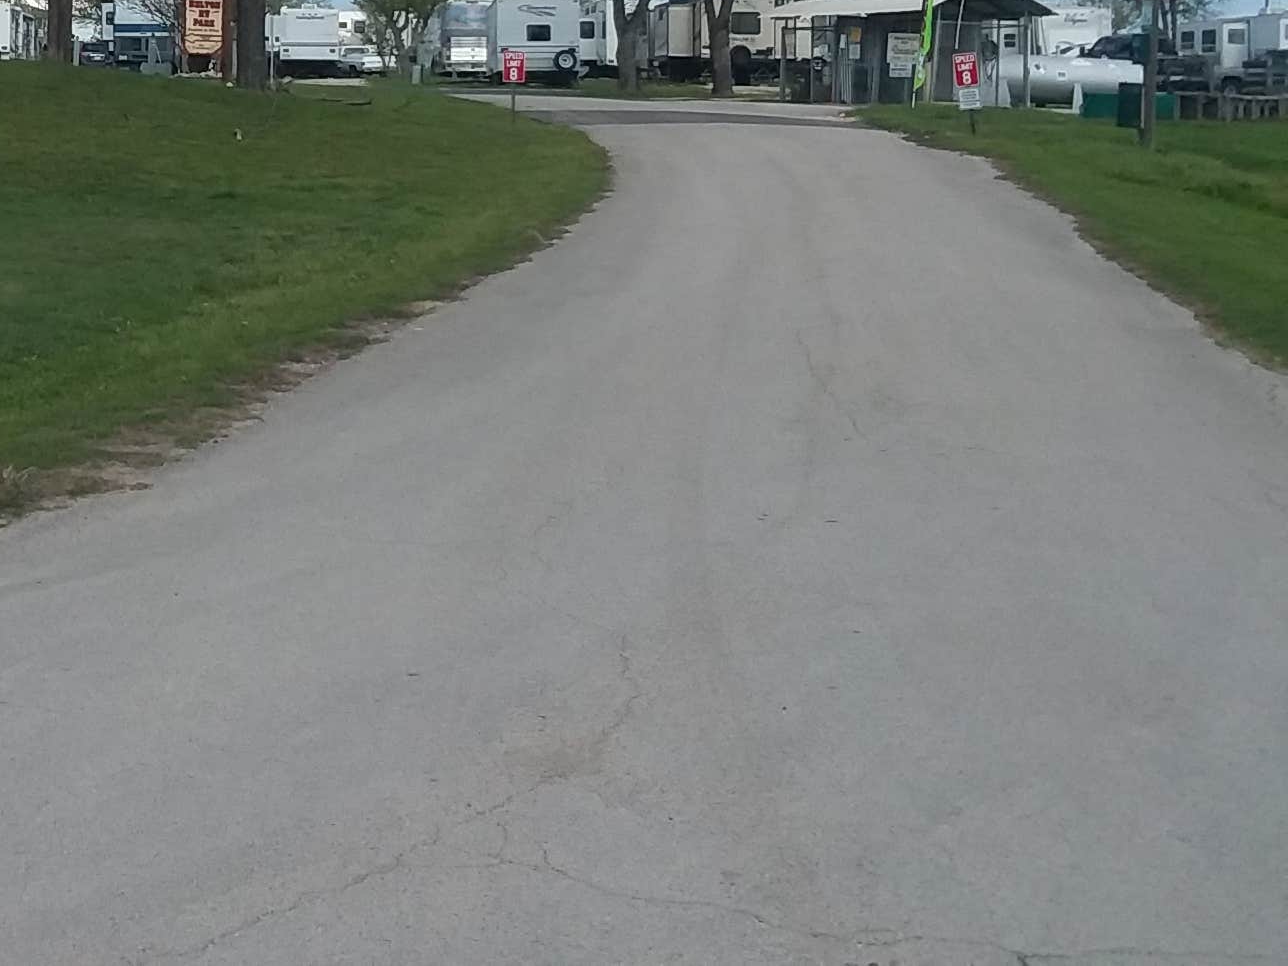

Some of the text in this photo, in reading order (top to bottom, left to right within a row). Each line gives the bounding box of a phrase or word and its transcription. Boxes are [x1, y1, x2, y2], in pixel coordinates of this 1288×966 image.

[198, 9, 210, 18] RV
[504, 52, 524, 60] SPEED
[954, 54, 976, 63] SPEED
[506, 59, 522, 67] LIMIT
[957, 62, 974, 71] LIMIT
[509, 67, 518, 81] 8
[962, 71, 972, 84] 8
